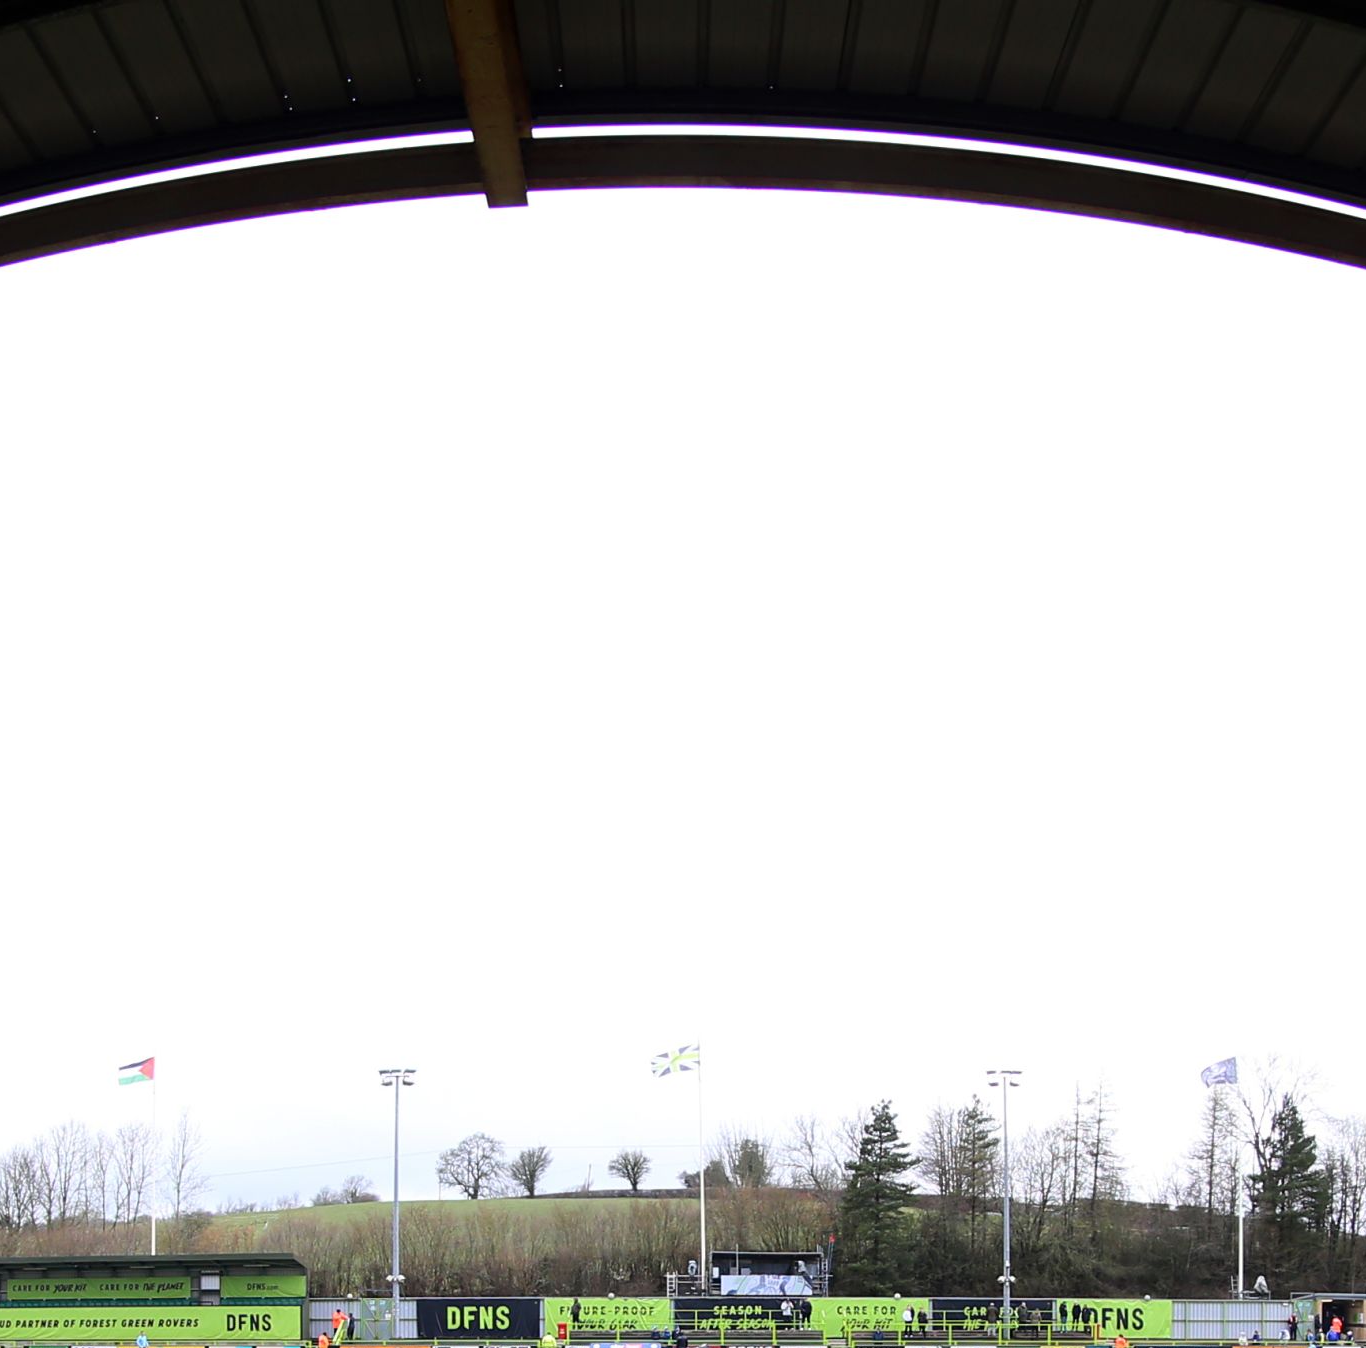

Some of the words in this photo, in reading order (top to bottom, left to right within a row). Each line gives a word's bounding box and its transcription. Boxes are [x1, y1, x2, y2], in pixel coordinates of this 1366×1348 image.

[12, 1284, 32, 1292] CARE
[36, 1284, 51, 1292] FOR
[53, 1284, 73, 1293] YOUR
[100, 1283, 120, 1291] CARE
[123, 1283, 140, 1291] FOR
[156, 1282, 185, 1293] PLANET
[713, 1305, 762, 1316] SEASON
[836, 1305, 867, 1315] CARE
[873, 1305, 897, 1315] FOR
[15, 1319, 59, 1328] PARTNER
[63, 1319, 76, 1328] OF
[79, 1318, 117, 1328] FOREST
[121, 1318, 155, 1328] GREEN
[158, 1318, 200, 1328] ROVERS
[226, 1313, 272, 1332] DFNS
[446, 1305, 510, 1331] DFNS
[700, 1318, 733, 1330] AFTER
